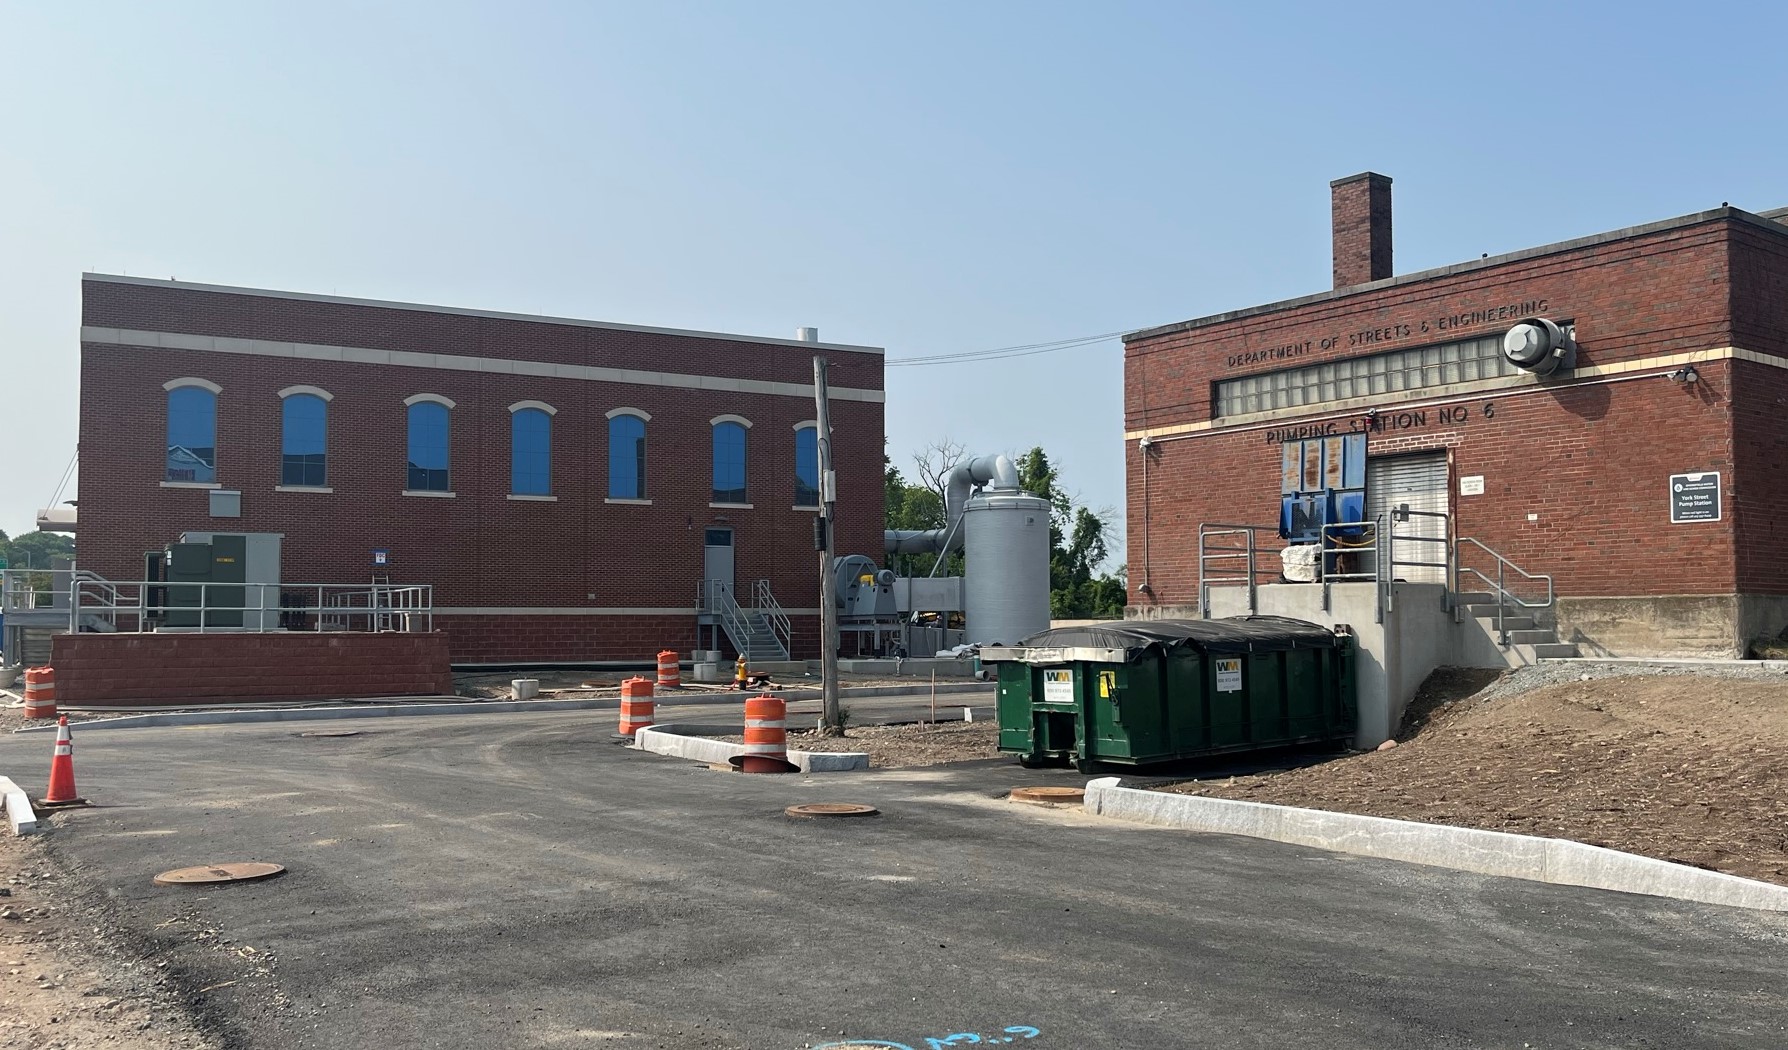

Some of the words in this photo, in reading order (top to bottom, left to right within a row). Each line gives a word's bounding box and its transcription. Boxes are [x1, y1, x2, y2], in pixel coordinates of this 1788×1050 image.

[1228, 341, 1312, 367] DEPARTMENT
[1321, 336, 1339, 350] OF
[1350, 324, 1411, 346] STREETS
[1439, 300, 1549, 330] ENGINEERING
[1266, 422, 1337, 446] PUMPING
[1484, 403, 1495, 419] 6
[1046, 672, 1070, 682] WM
[1217, 661, 1239, 672] WM
